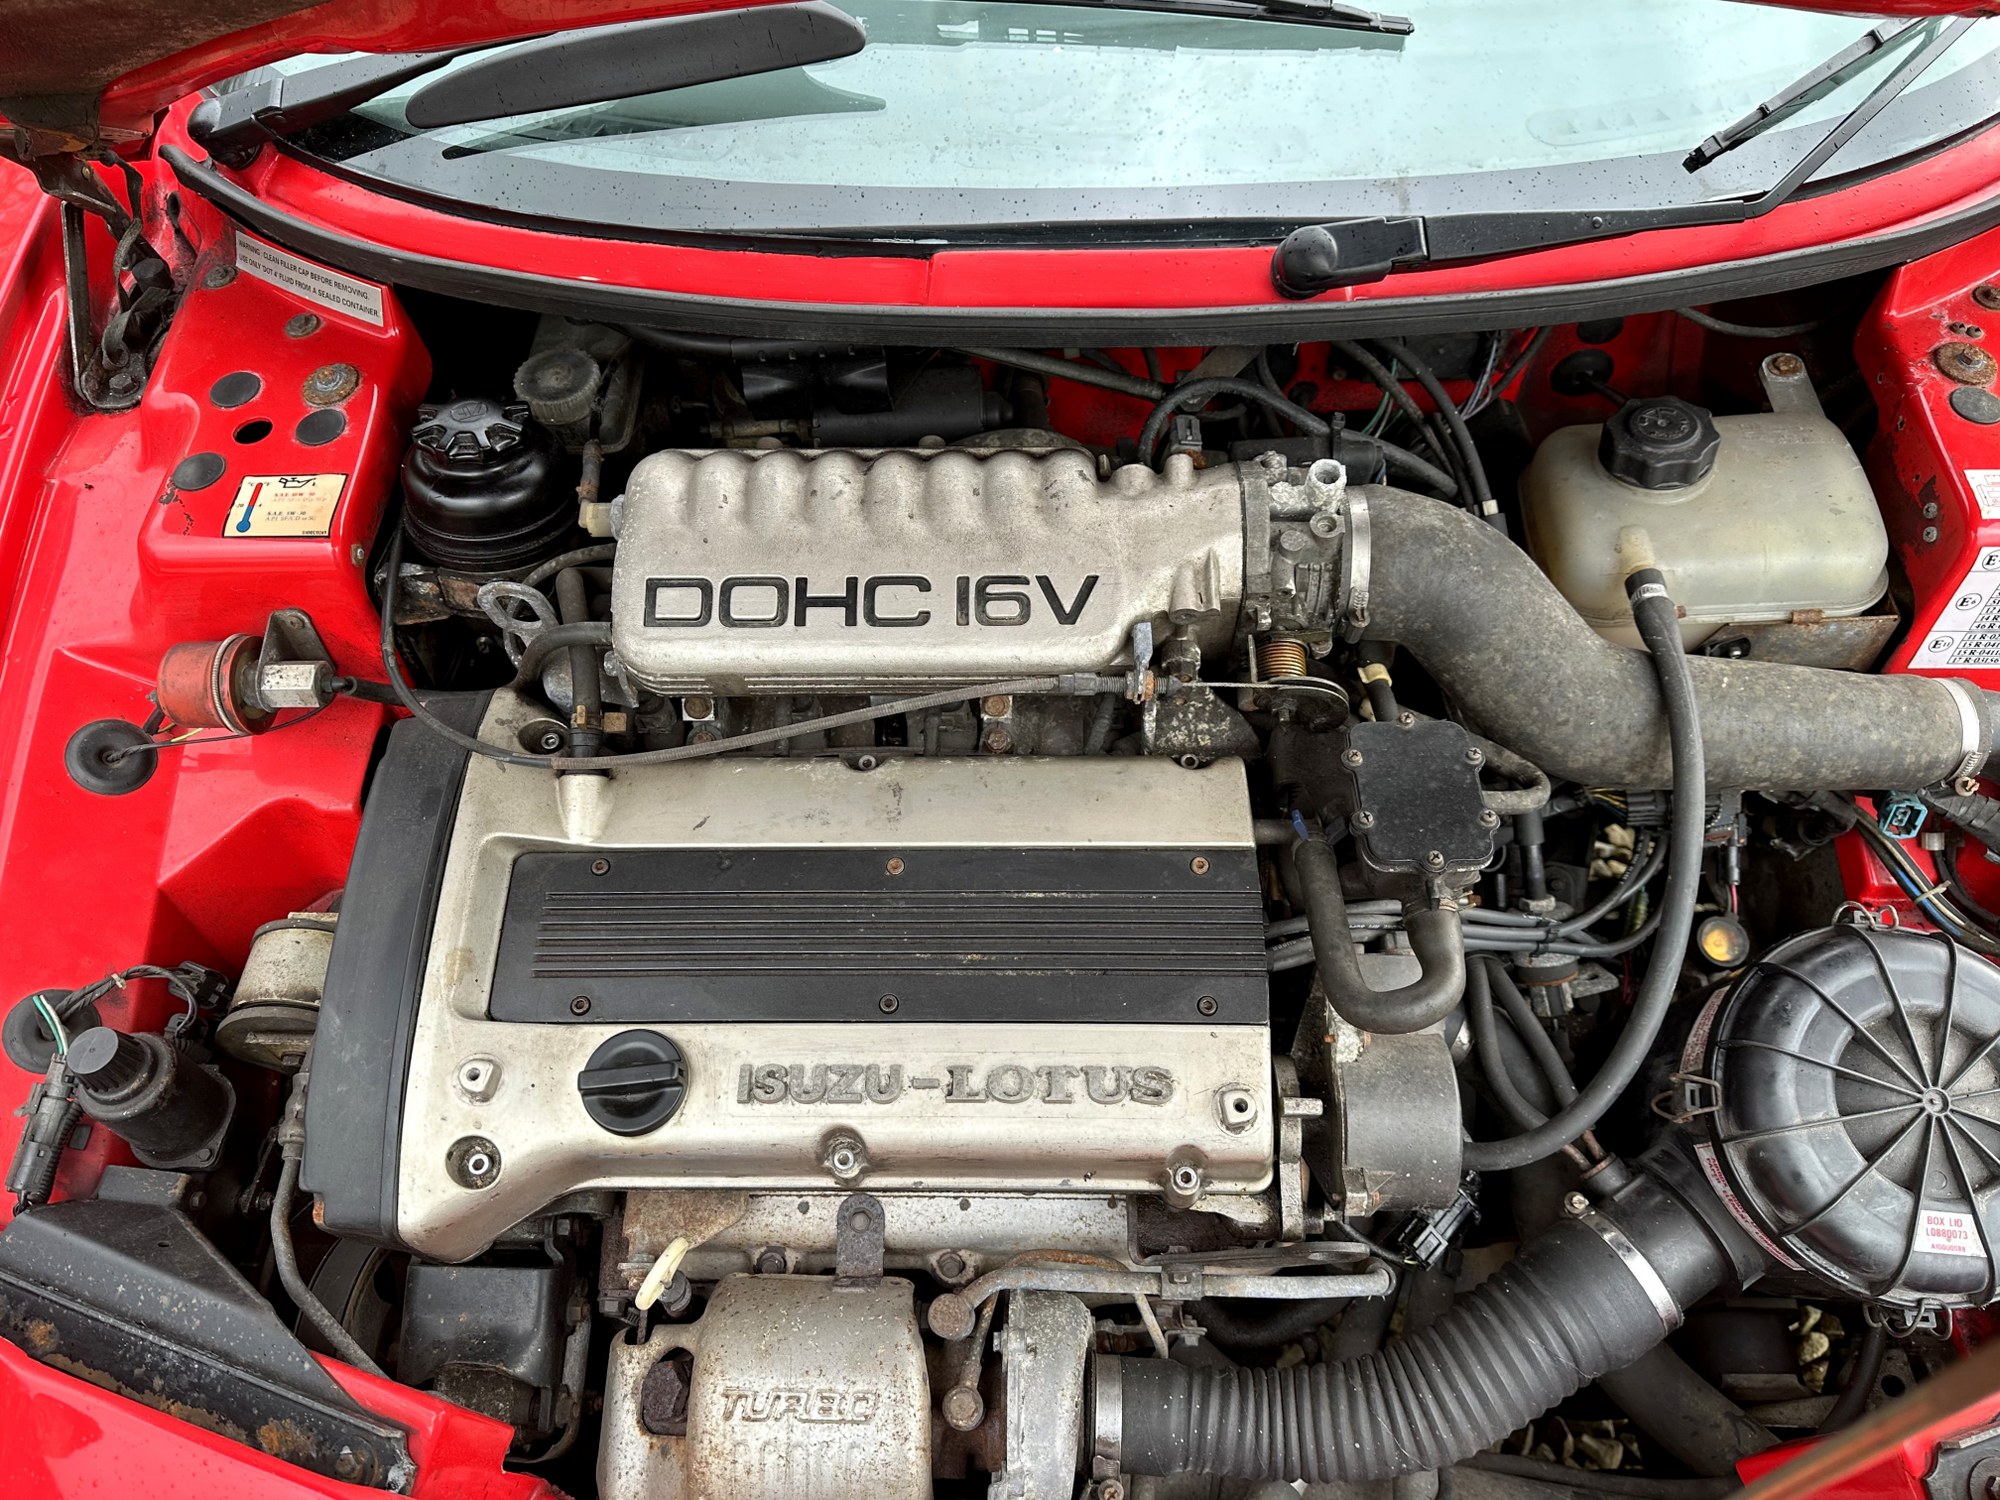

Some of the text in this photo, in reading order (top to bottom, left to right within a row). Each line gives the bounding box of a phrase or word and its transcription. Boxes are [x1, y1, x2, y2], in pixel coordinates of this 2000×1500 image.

[248, 258, 262, 270] ONLY
[279, 272, 295, 284] FLUID
[295, 280, 312, 292] FROM
[317, 289, 341, 304] SEALED
[263, 251, 280, 265] CLEAN
[280, 259, 298, 272] FILLER
[297, 266, 310, 276] CAP
[310, 271, 334, 287] BEFORE
[643, 574, 1100, 627] DOHC 16V
[737, 1063, 1178, 1105] ISUZU-LOTUS
[1927, 1215, 1963, 1228] BOX LID
[721, 1387, 877, 1425] TURBO
